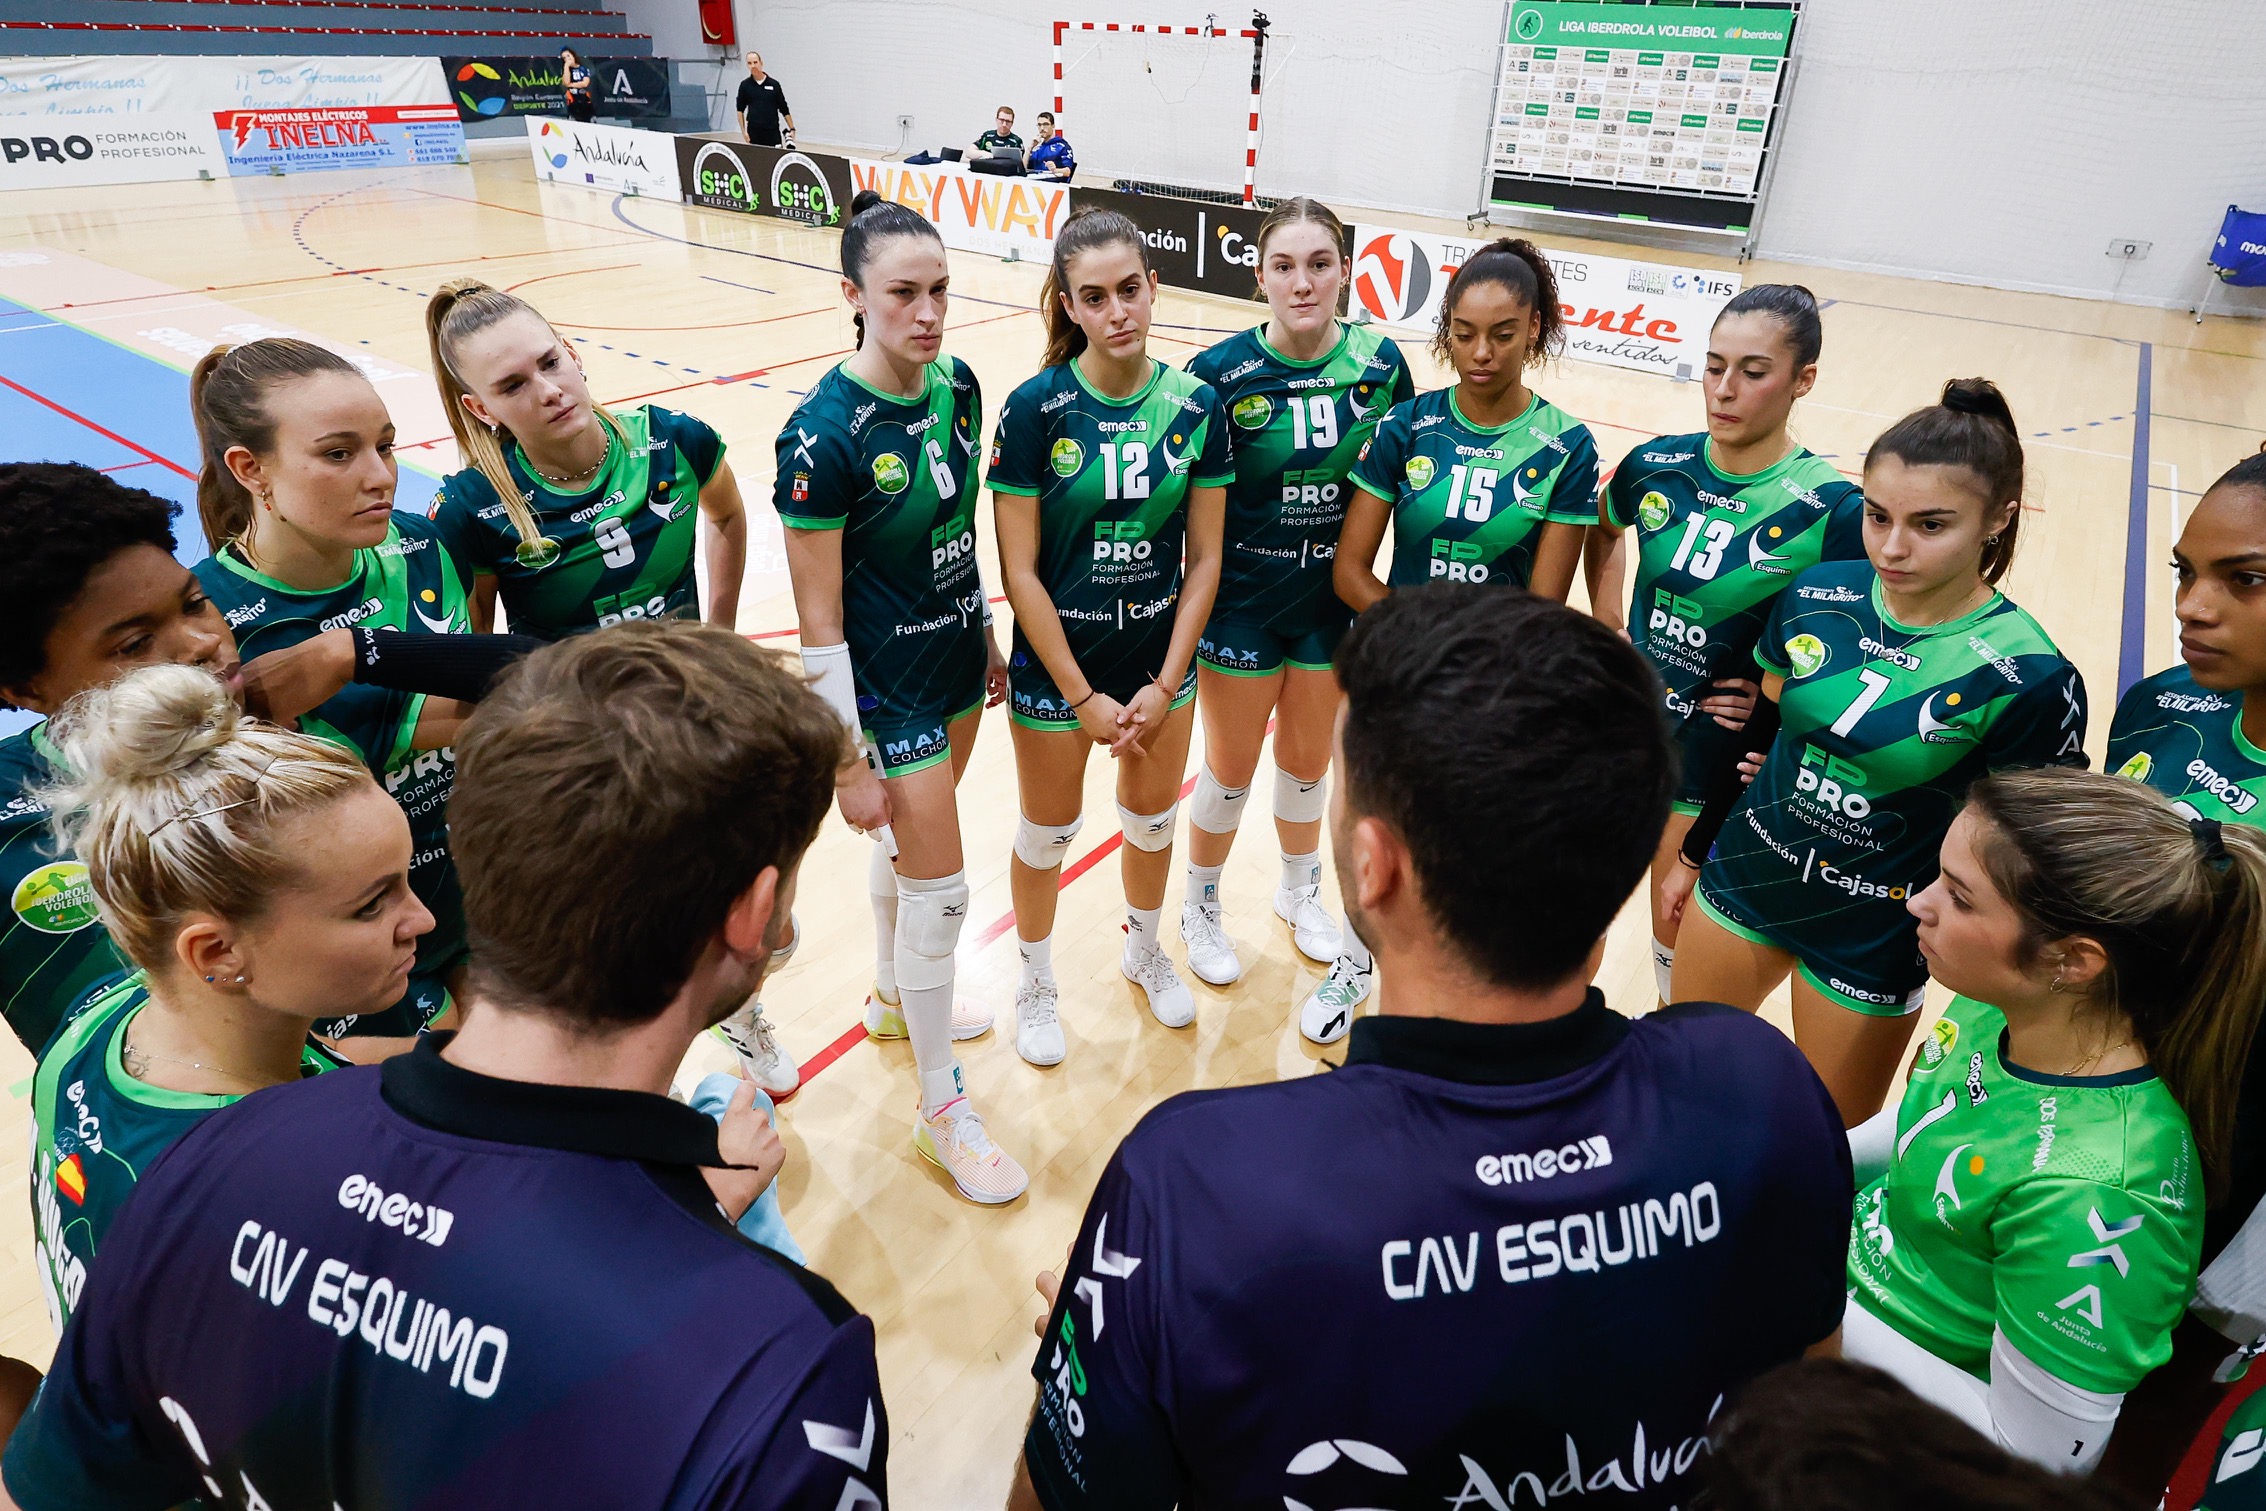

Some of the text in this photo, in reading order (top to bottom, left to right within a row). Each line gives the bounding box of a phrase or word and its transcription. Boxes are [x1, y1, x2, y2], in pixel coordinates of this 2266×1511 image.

[1559, 20, 1718, 39] LIGA IBERDROLA VOLEIBOL
[260, 111, 310, 124] MONTAJES
[1, 134, 94, 164] PRO
[95, 130, 187, 144] FORMACIÓN
[262, 120, 377, 151] INELNA
[100, 145, 206, 159] PROFESIONAL
[573, 132, 651, 174] Andalucía
[703, 196, 743, 209] MEDICAL
[1708, 281, 1733, 296] IFS
[1572, 337, 1679, 365] sentidos
[1287, 377, 1326, 389] emec
[1098, 421, 1136, 432] emec
[1287, 394, 1339, 450] 19
[1455, 444, 1492, 459] emec
[925, 438, 957, 501] 6
[1099, 441, 1150, 500] 12
[1283, 468, 1335, 486] FP
[1282, 483, 1340, 506] PRO
[1445, 463, 1499, 523] 15
[1521, 500, 1544, 511] Esquimo
[1697, 489, 1735, 511] emec
[569, 498, 614, 524] emec
[1281, 502, 1342, 515] FORMACIÓN
[931, 513, 967, 550] FP
[1094, 521, 1146, 540] FP
[932, 530, 973, 571] PRO
[1093, 540, 1152, 563] PRO
[1431, 537, 1483, 560] FP
[1669, 510, 1736, 581] 13
[1092, 559, 1154, 573] FORMACIÓN
[1092, 569, 1161, 584] PROFESIONAL
[1429, 557, 1489, 584] PRO
[1756, 562, 1791, 575] Esquimo
[593, 583, 657, 618] FP
[1055, 588, 1178, 622] undación Cajasol
[1654, 587, 1704, 620] FP
[319, 602, 368, 633] emec
[895, 613, 957, 637] Fundación
[1649, 607, 1707, 648] PRO
[1197, 637, 1259, 662] MAX
[1198, 648, 1258, 670] COLCHON
[885, 724, 946, 756] MAX
[890, 736, 948, 765] COLCHON
[1801, 742, 1868, 787] FP
[1795, 766, 1871, 819] PRO
[2186, 759, 2240, 806] emec
[1787, 804, 1885, 852] PROFESIONAL
[1791, 791, 1873, 837] FORMACIÓN
[1745, 808, 1914, 900] Fundación Cajasol
[1829, 976, 1882, 1004] emec
[1475, 1143, 1582, 1187] emec
[1382, 1180, 1722, 1301] CAV ESQUIMO
[230, 1220, 510, 1400] CAV ESQUIMO
[2036, 1310, 2108, 1354] de Andalucía
[2059, 1314, 2091, 1338] Junta
